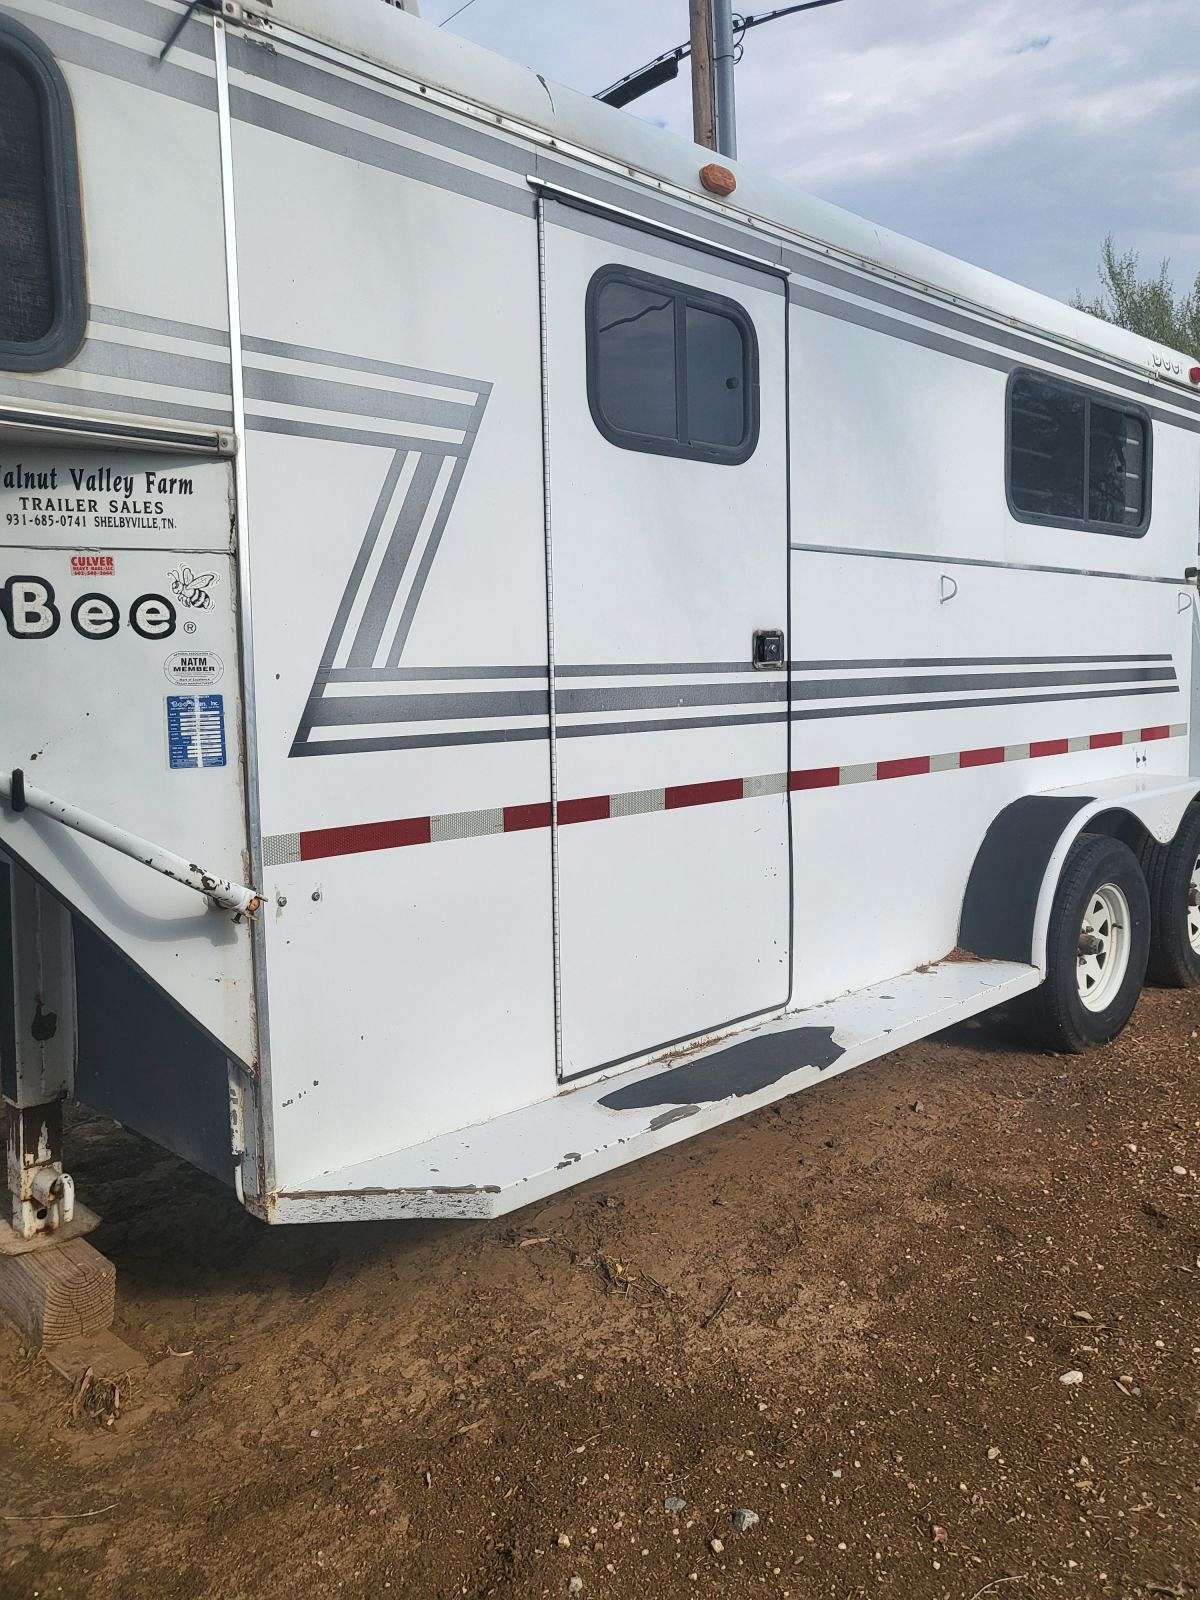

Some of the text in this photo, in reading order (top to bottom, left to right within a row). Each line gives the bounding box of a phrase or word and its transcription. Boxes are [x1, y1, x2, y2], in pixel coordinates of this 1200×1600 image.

[0, 463, 194, 498] alnut Valley Farm
[19, 497, 164, 514] TRAILER SALES
[6, 514, 87, 527] 931-685-0741
[70, 556, 114, 567] CULVER
[5, 575, 177, 640] Bee
[180, 657, 207, 667] NATM
